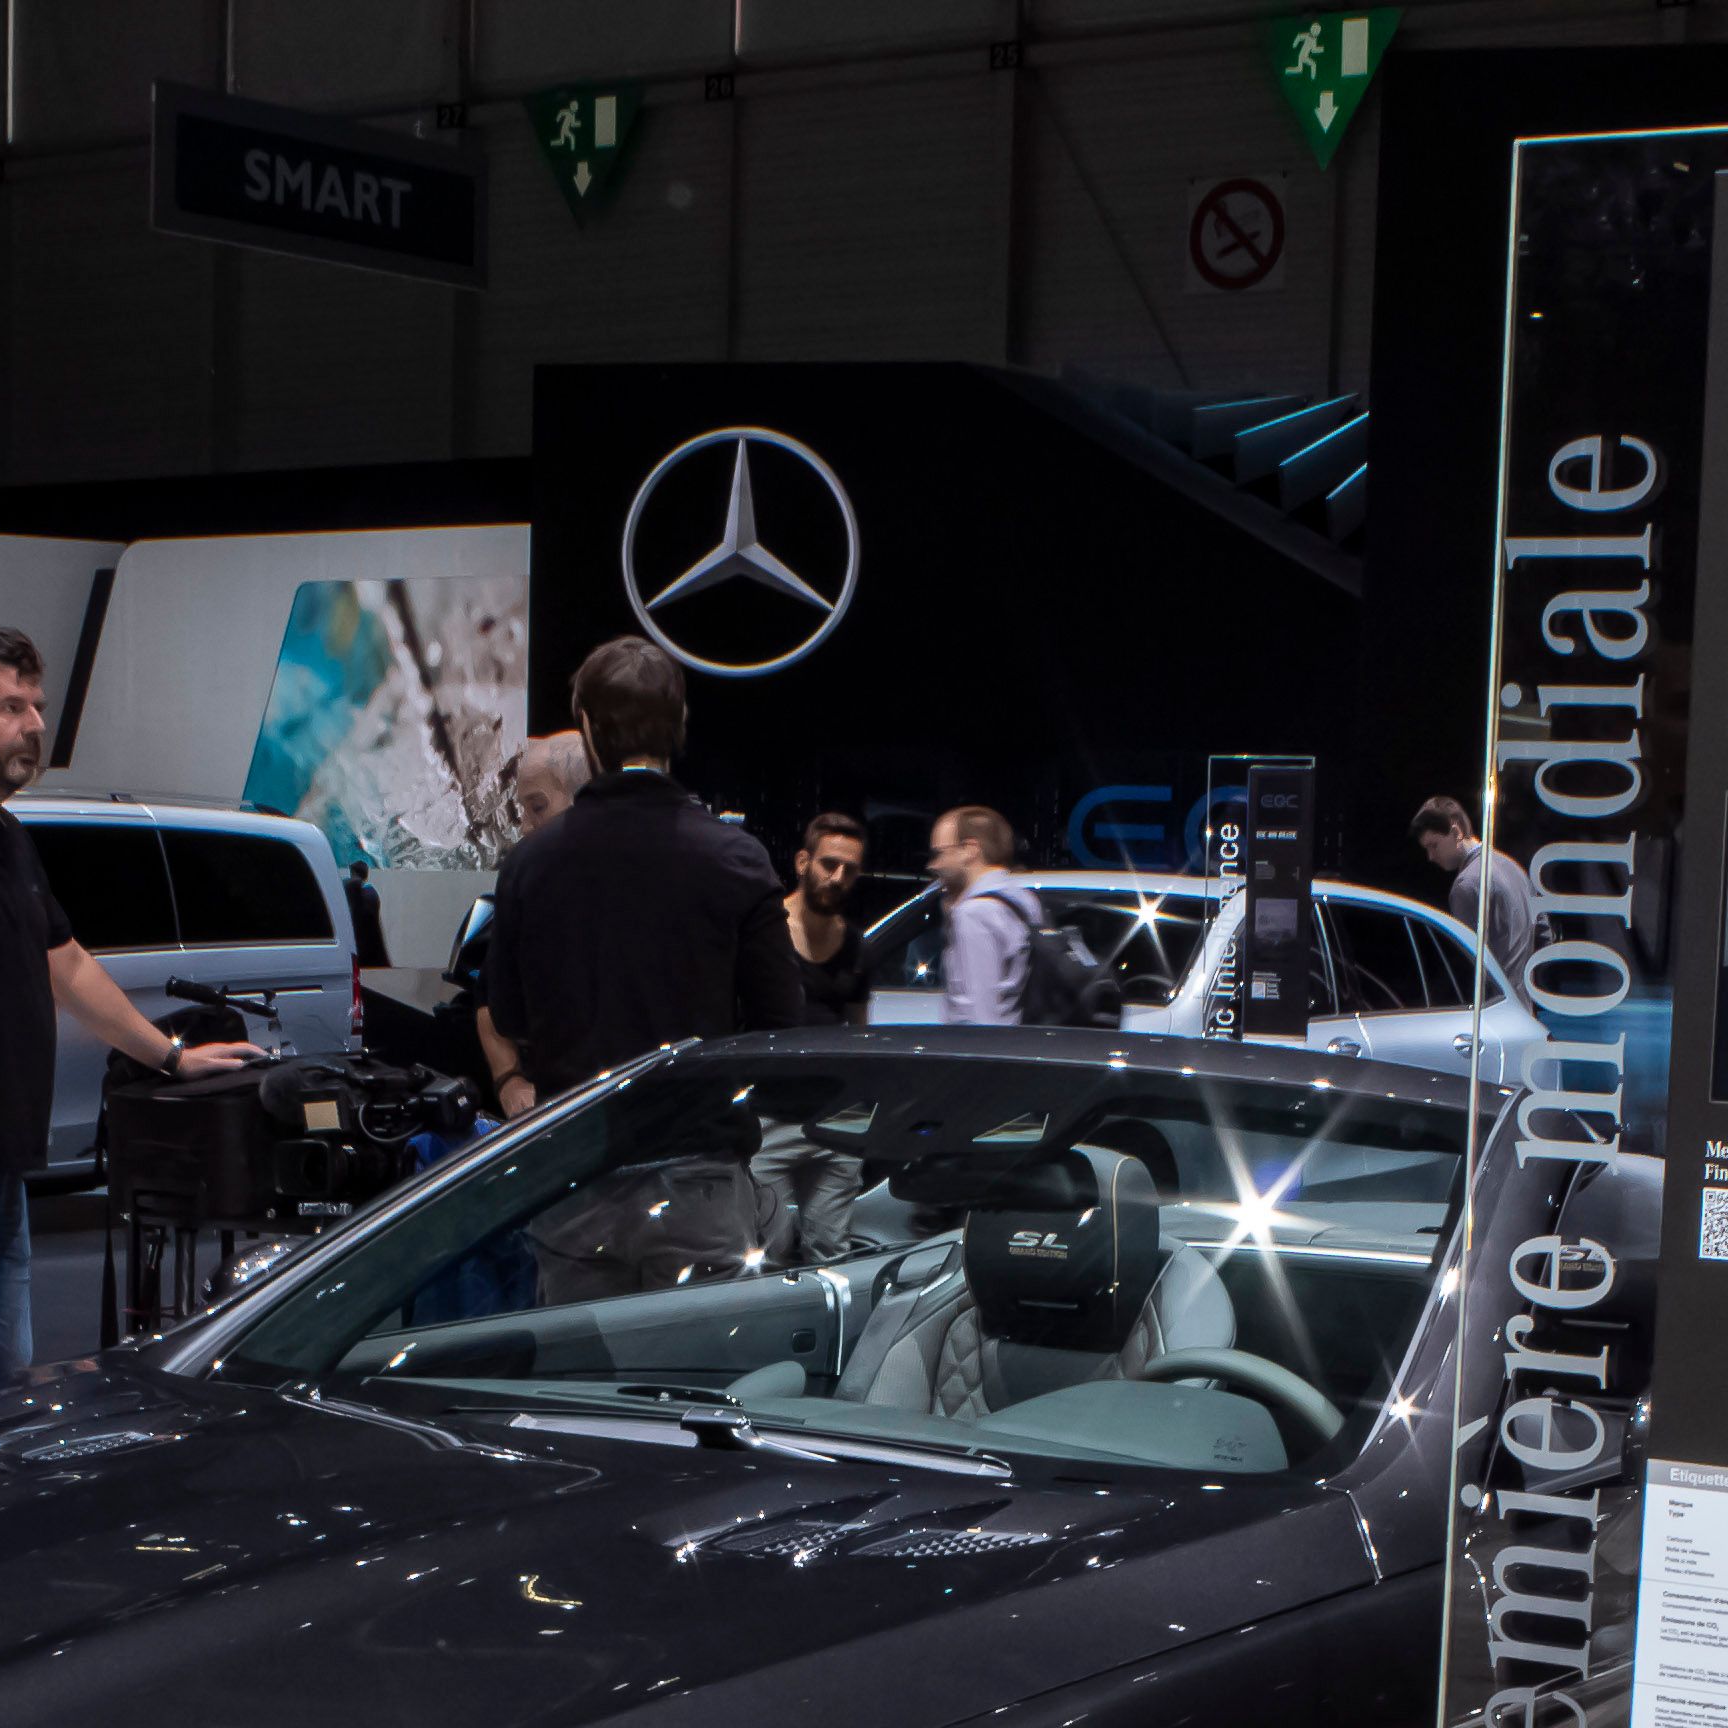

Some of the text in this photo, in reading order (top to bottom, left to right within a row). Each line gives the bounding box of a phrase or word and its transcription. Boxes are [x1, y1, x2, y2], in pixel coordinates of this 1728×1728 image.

[244, 147, 412, 229] SMART
[1261, 795, 1299, 808] EQC
[1497, 434, 1657, 1169] mondiale
[1008, 1231, 1069, 1249] SL
